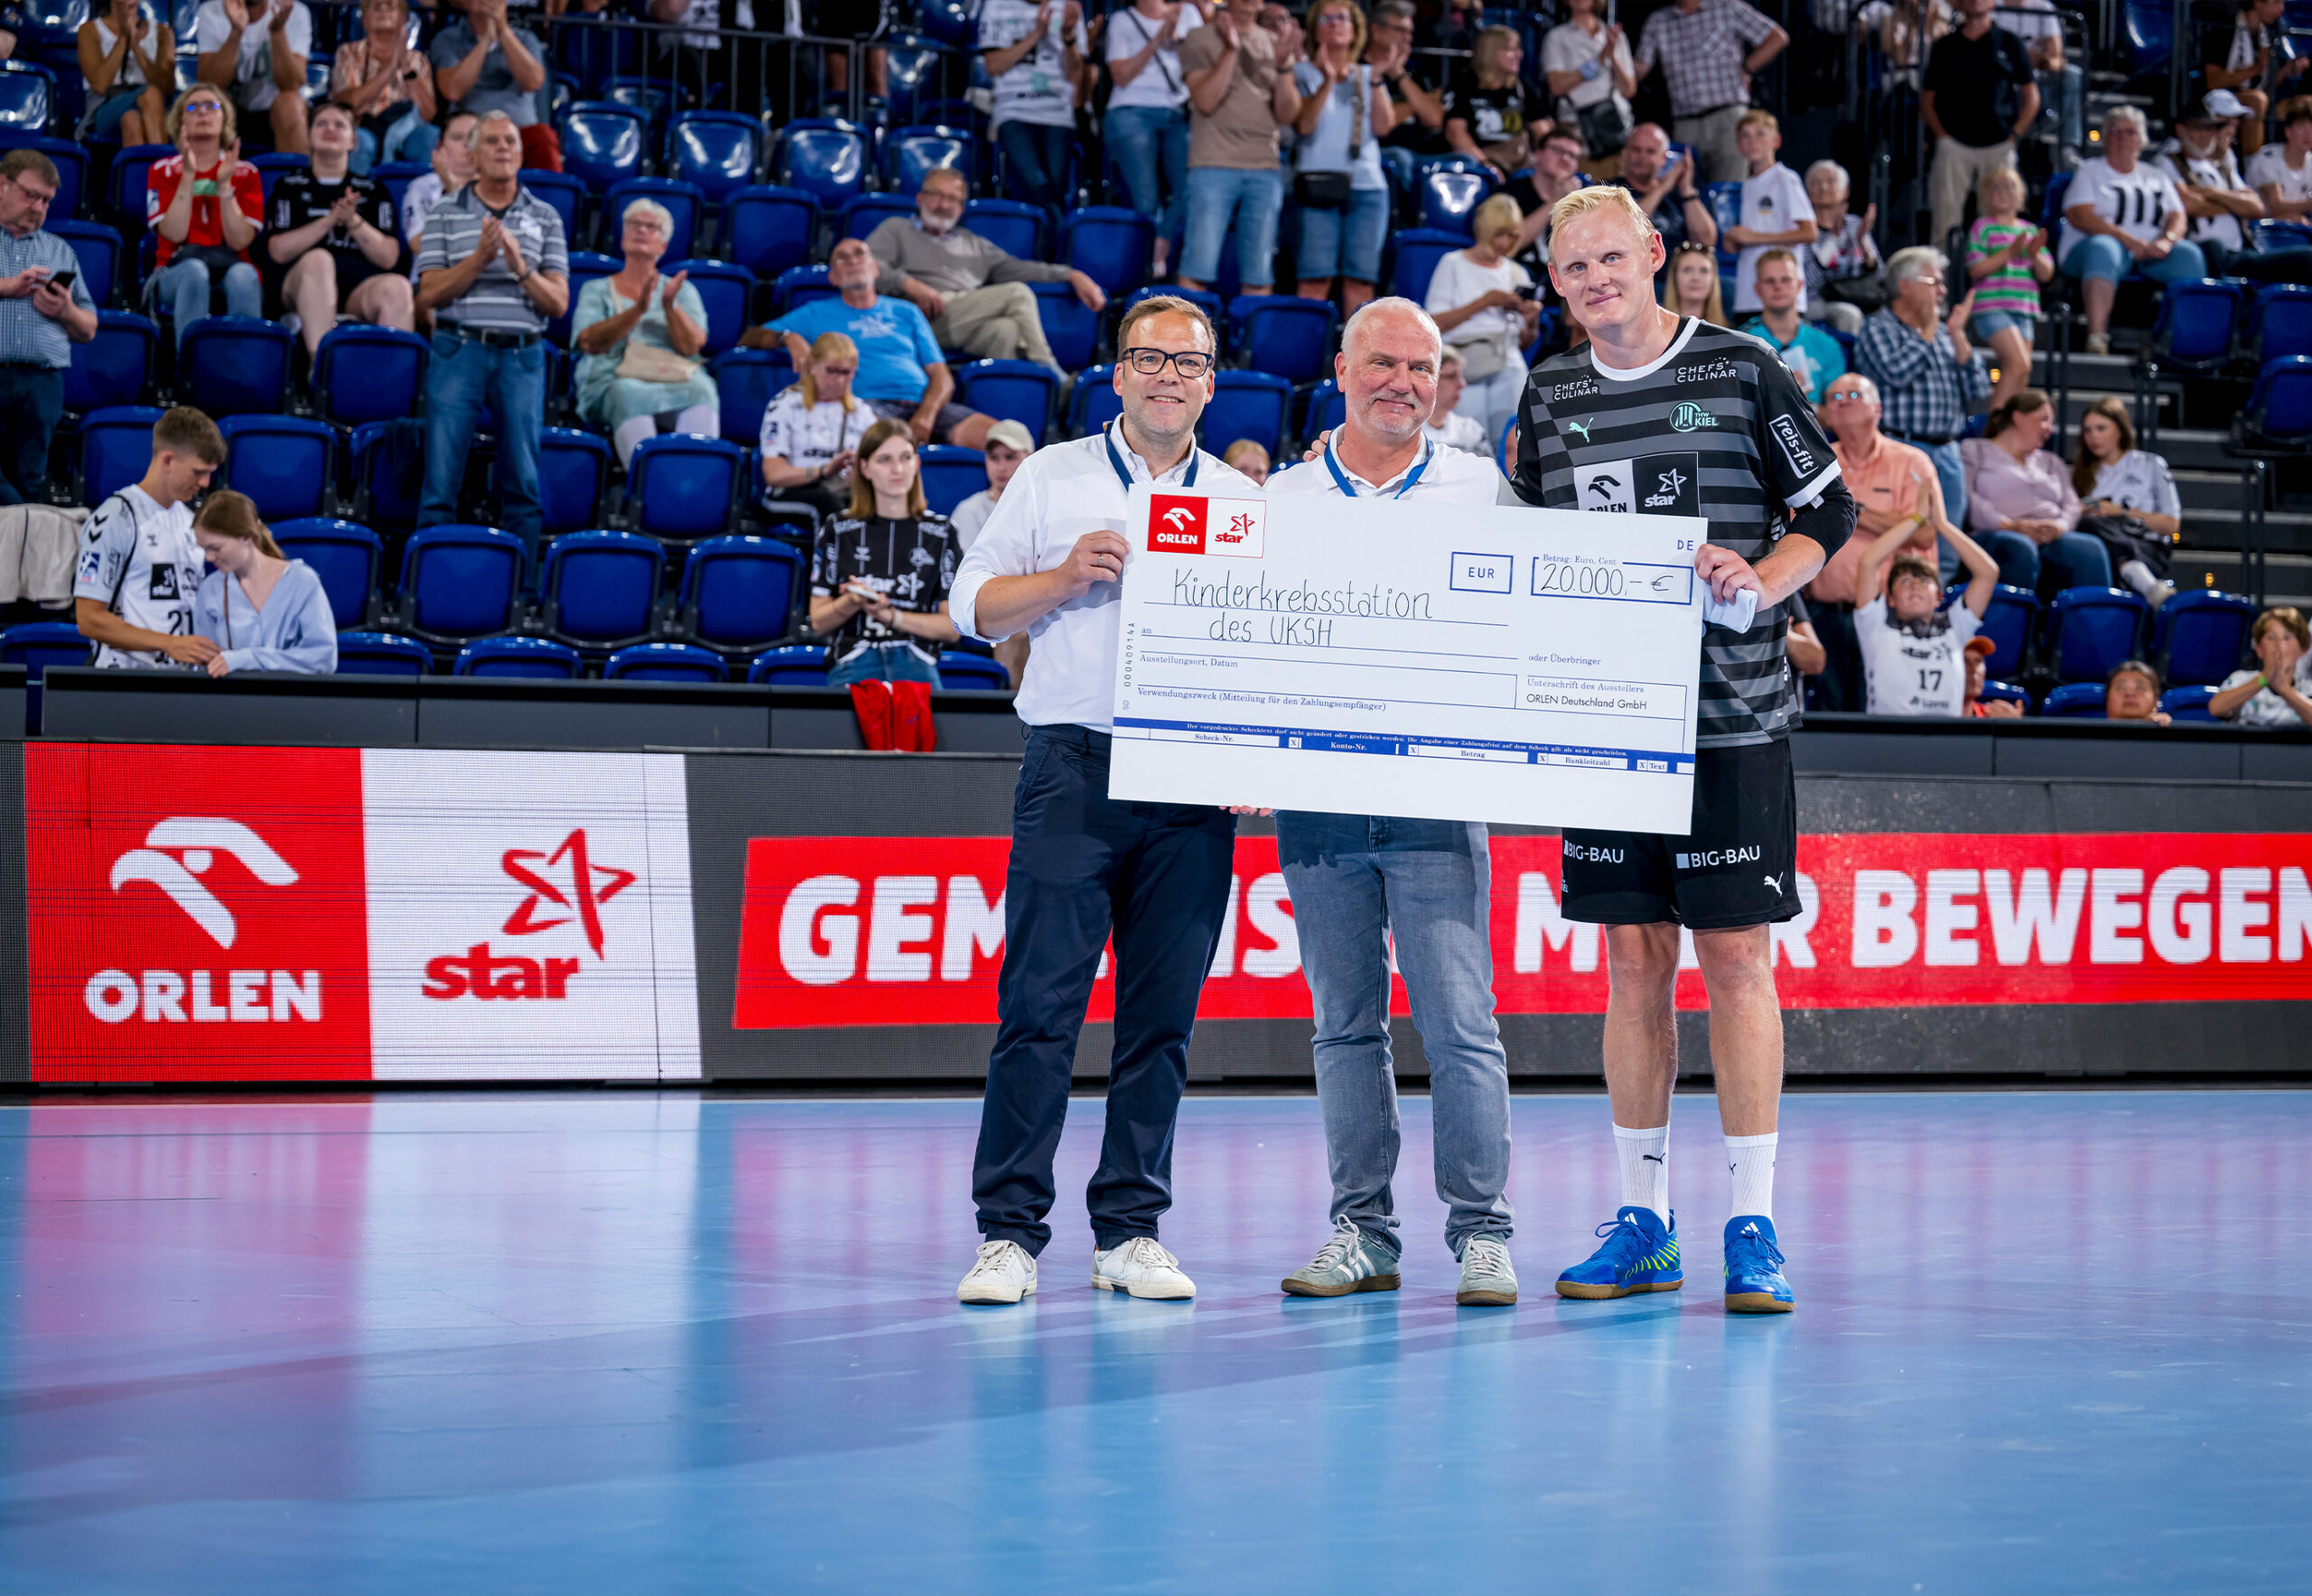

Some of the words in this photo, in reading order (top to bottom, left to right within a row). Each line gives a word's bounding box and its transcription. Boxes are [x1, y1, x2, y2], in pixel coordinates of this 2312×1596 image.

[1677, 369, 1737, 383] CULINAR
[1553, 387, 1599, 401] CULINAR
[1694, 416, 1719, 426] KIEL
[1776, 419, 1815, 471] reis-fit
[1645, 493, 1676, 508] star
[1157, 532, 1198, 545] ORLEN
[1215, 532, 1244, 544] star
[1677, 539, 1694, 551] DE
[1543, 554, 1573, 564] Betrag:
[1599, 556, 1617, 565] Cent
[1468, 566, 1495, 579] EUR
[1174, 568, 1432, 620] Kinderkrebsstation
[1209, 611, 1252, 642] des
[1270, 615, 1332, 647] UKSH
[1140, 654, 1208, 667] Ausstellungsort,
[1210, 658, 1238, 667] Datum
[1528, 654, 1548, 662] oder
[1550, 653, 1601, 666] Überbringer
[1527, 678, 1579, 689] Unterschrift
[1580, 682, 1596, 690] des
[1598, 683, 1645, 693] Ausstellers
[1919, 669, 1943, 692] 17
[1138, 687, 1217, 700] Verwendungszweck
[1219, 692, 1266, 705] (Mitteilung
[1268, 695, 1282, 705] für
[1282, 696, 1298, 705] den
[1300, 697, 1387, 712] Zahlungsempfänger)
[1526, 693, 1559, 704] ORLEN
[1561, 695, 1615, 708] Deutschland
[1617, 699, 1647, 710] GmbH
[1194, 733, 1234, 742] Scheck-Nr.
[1330, 742, 1367, 751] Konto-Nr.
[1460, 750, 1486, 759] Betrag
[1565, 756, 1611, 767] Bankleitzahl
[1648, 762, 1665, 770] Text
[1569, 843, 1624, 863] BIG-BAU
[1691, 845, 1760, 868] BIG-BAU
[422, 941, 581, 999] star
[84, 967, 324, 1023] ORLEN
